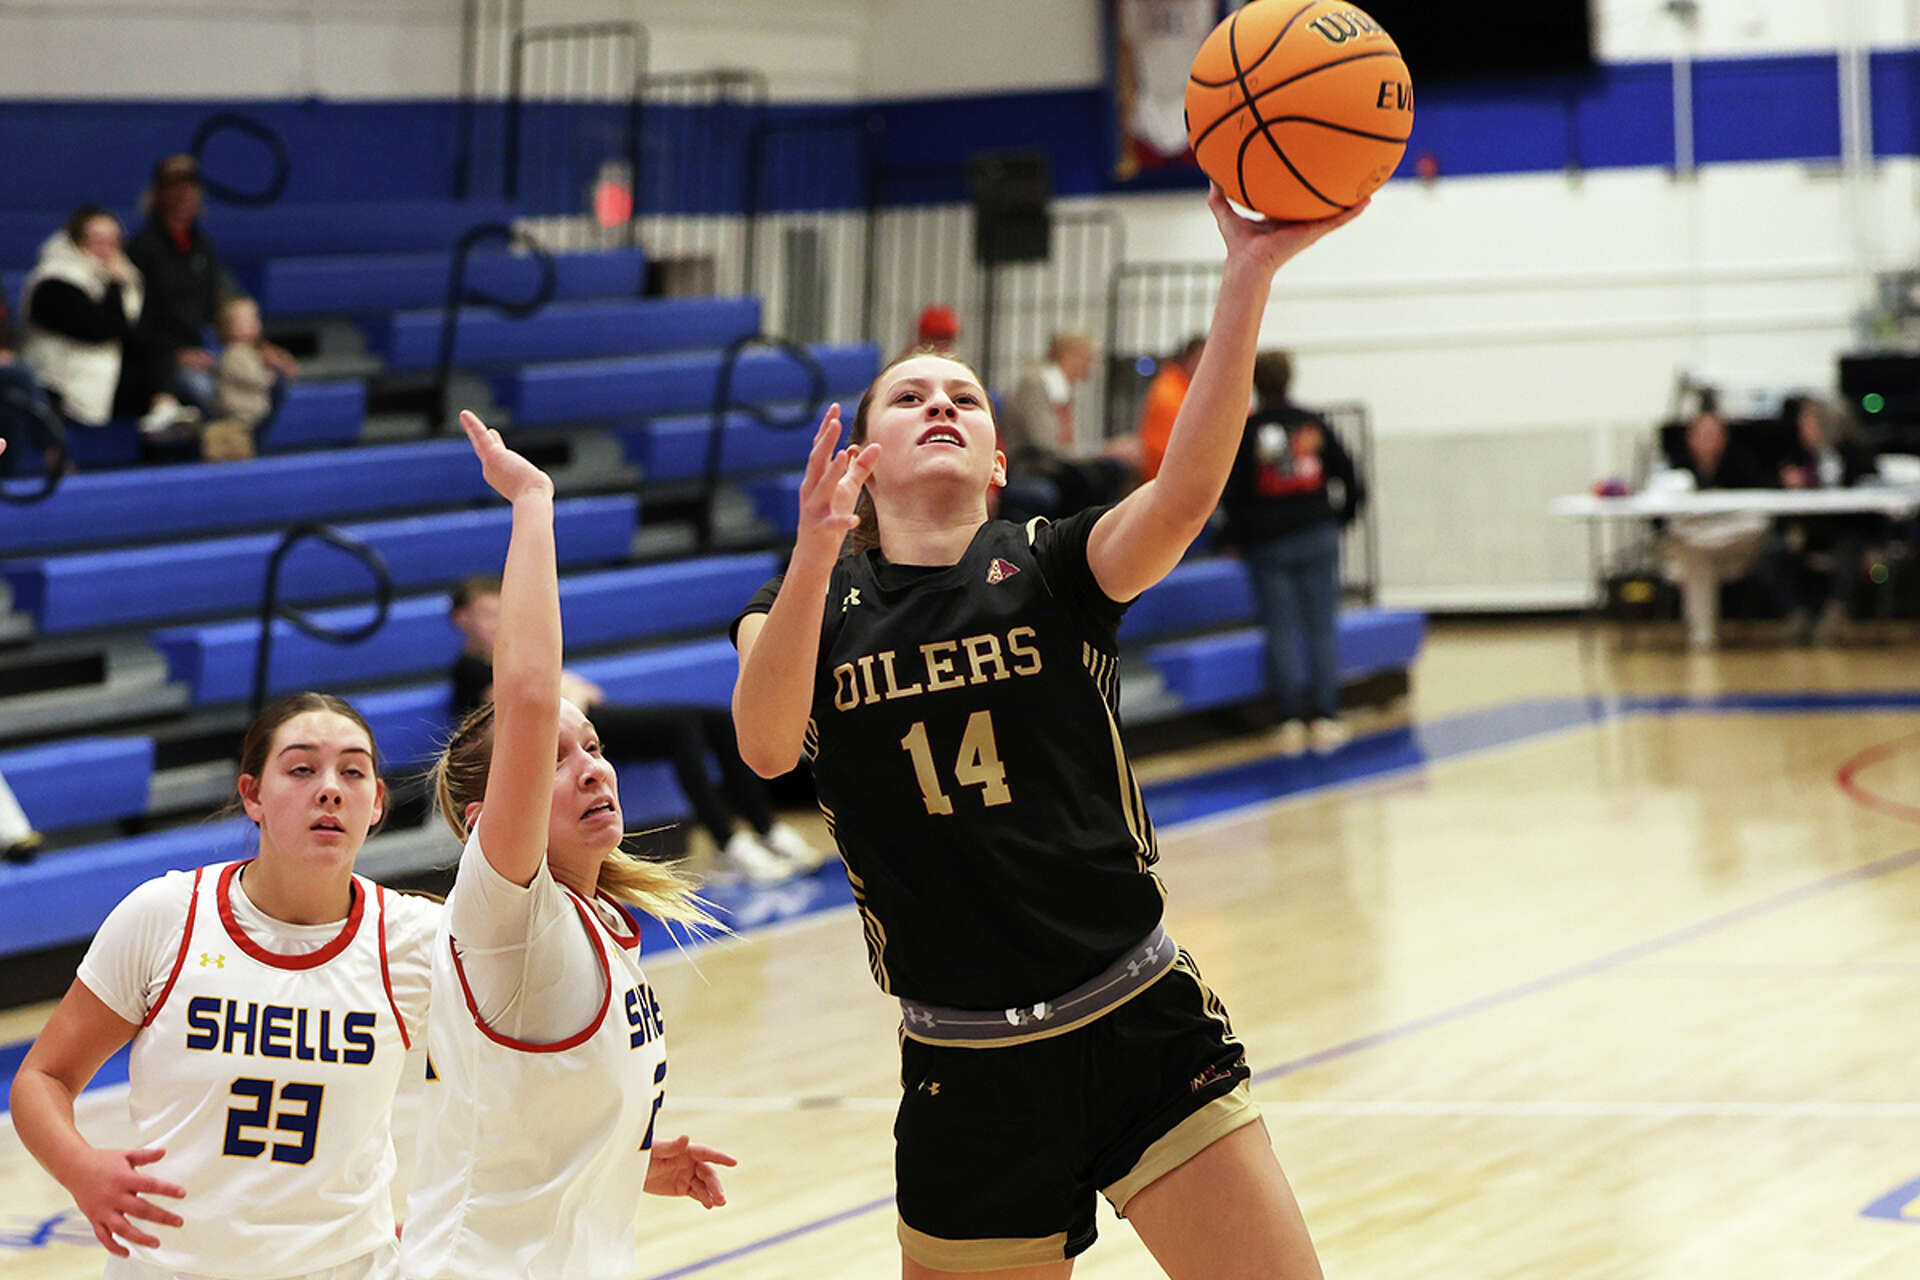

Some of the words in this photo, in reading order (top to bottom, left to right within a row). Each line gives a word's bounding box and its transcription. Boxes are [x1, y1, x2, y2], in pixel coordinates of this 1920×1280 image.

[833, 626, 1042, 712] OILERS
[900, 709, 1012, 815] 14
[186, 995, 377, 1066] SHELLS
[222, 1076, 327, 1166] 23
